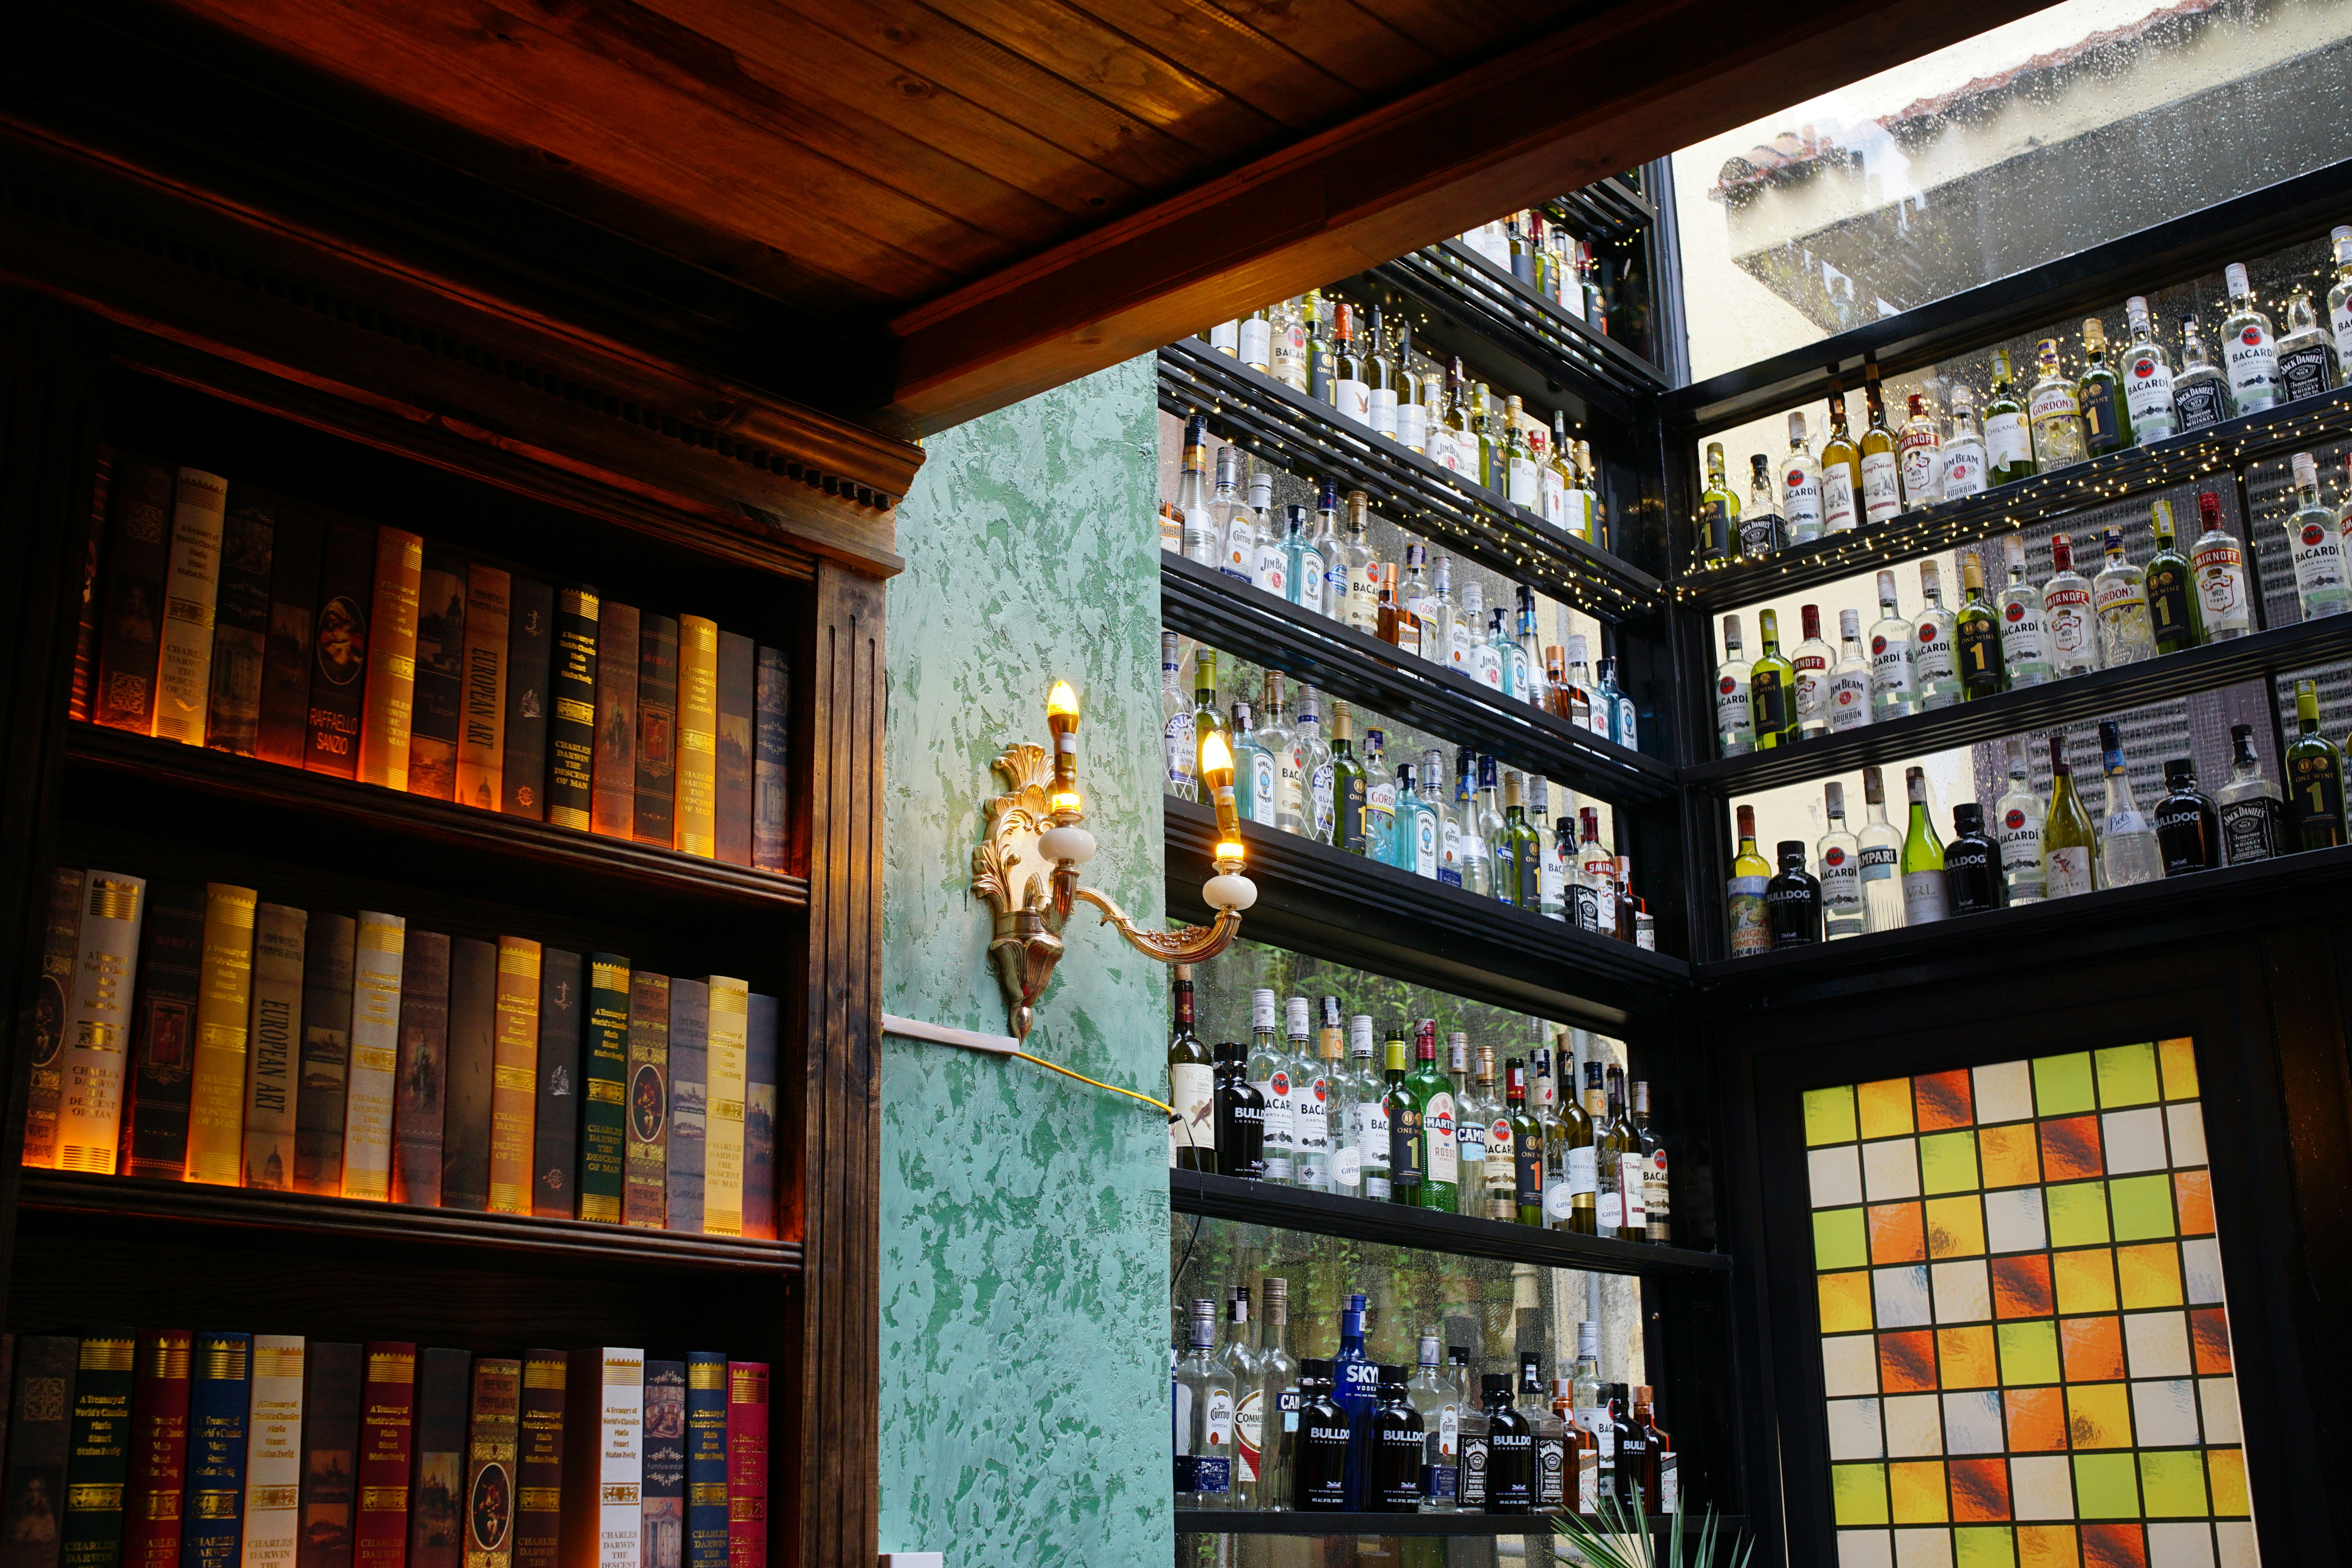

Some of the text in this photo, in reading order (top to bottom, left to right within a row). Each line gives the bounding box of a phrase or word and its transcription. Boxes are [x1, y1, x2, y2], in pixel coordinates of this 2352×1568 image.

[2281, 354, 2324, 374] JACK DANIEL'S
[2291, 377, 2319, 388] Tennessee
[2176, 386, 2214, 406] JACK DANIEL'S
[2292, 384, 2319, 395] WHISKEY
[2033, 398, 2074, 415] GORDON'S
[2091, 396, 2109, 405] WINE
[2086, 407, 2100, 434] 1
[2187, 417, 2214, 427] WHISKEY
[1987, 424, 2018, 436] CHILANO
[1943, 453, 1979, 473] JIM BEAM
[1947, 483, 1977, 498] BOURBON
[1740, 524, 1752, 536] JACK
[1233, 532, 1251, 545] Cuervo
[1261, 557, 1274, 571] JIM
[1307, 559, 1319, 572] BOMBAY
[2097, 587, 2134, 604] GORDON'S
[2156, 596, 2170, 626] 1
[1970, 642, 1985, 670] 1
[469, 648, 497, 719] EUROPEAN
[1830, 679, 1864, 698] JIM BEAM
[1756, 695, 1767, 721] 1
[310, 708, 357, 735] RAFFAELLO
[1833, 711, 1862, 723] BOURBON
[468, 714, 493, 749] ART
[316, 732, 348, 755] SANZIO
[555, 741, 591, 754] CHARLES
[557, 750, 588, 763] DARWIN
[565, 761, 581, 770] THE
[1258, 760, 1272, 774] BOMBAY
[554, 768, 590, 781] DESCENT
[2295, 774, 2310, 782] ONE
[570, 780, 588, 789] MAN
[1257, 792, 1272, 803] SAPPHIRE
[2306, 782, 2324, 813] 1
[1358, 806, 1366, 835] 1
[2224, 806, 2266, 825] JACK DANIEL'S
[1421, 817, 1434, 830] BOMBAY
[2107, 811, 2130, 835] Bols
[1445, 831, 1460, 844] Cuervo
[2233, 831, 2260, 840] Tennessee
[2234, 838, 2261, 848] WHISKEY
[1859, 850, 1894, 867] AMPARI
[1767, 890, 1810, 902] BULLDOG
[257, 998, 290, 1079] EUROPEAN
[256, 1081, 285, 1113] ART
[598, 1144, 613, 1153] THE
[708, 1141, 741, 1152] CHARLES
[709, 1151, 739, 1161] DARWIN
[1407, 1138, 1418, 1169] 1
[717, 1161, 731, 1169] THE
[708, 1169, 740, 1180] DESCENT
[1210, 1409, 1229, 1421] Cuervo
[693, 1530, 728, 1539] CHARLES
[248, 1538, 293, 1548] CHARLES
[250, 1550, 290, 1559] DARWIN
